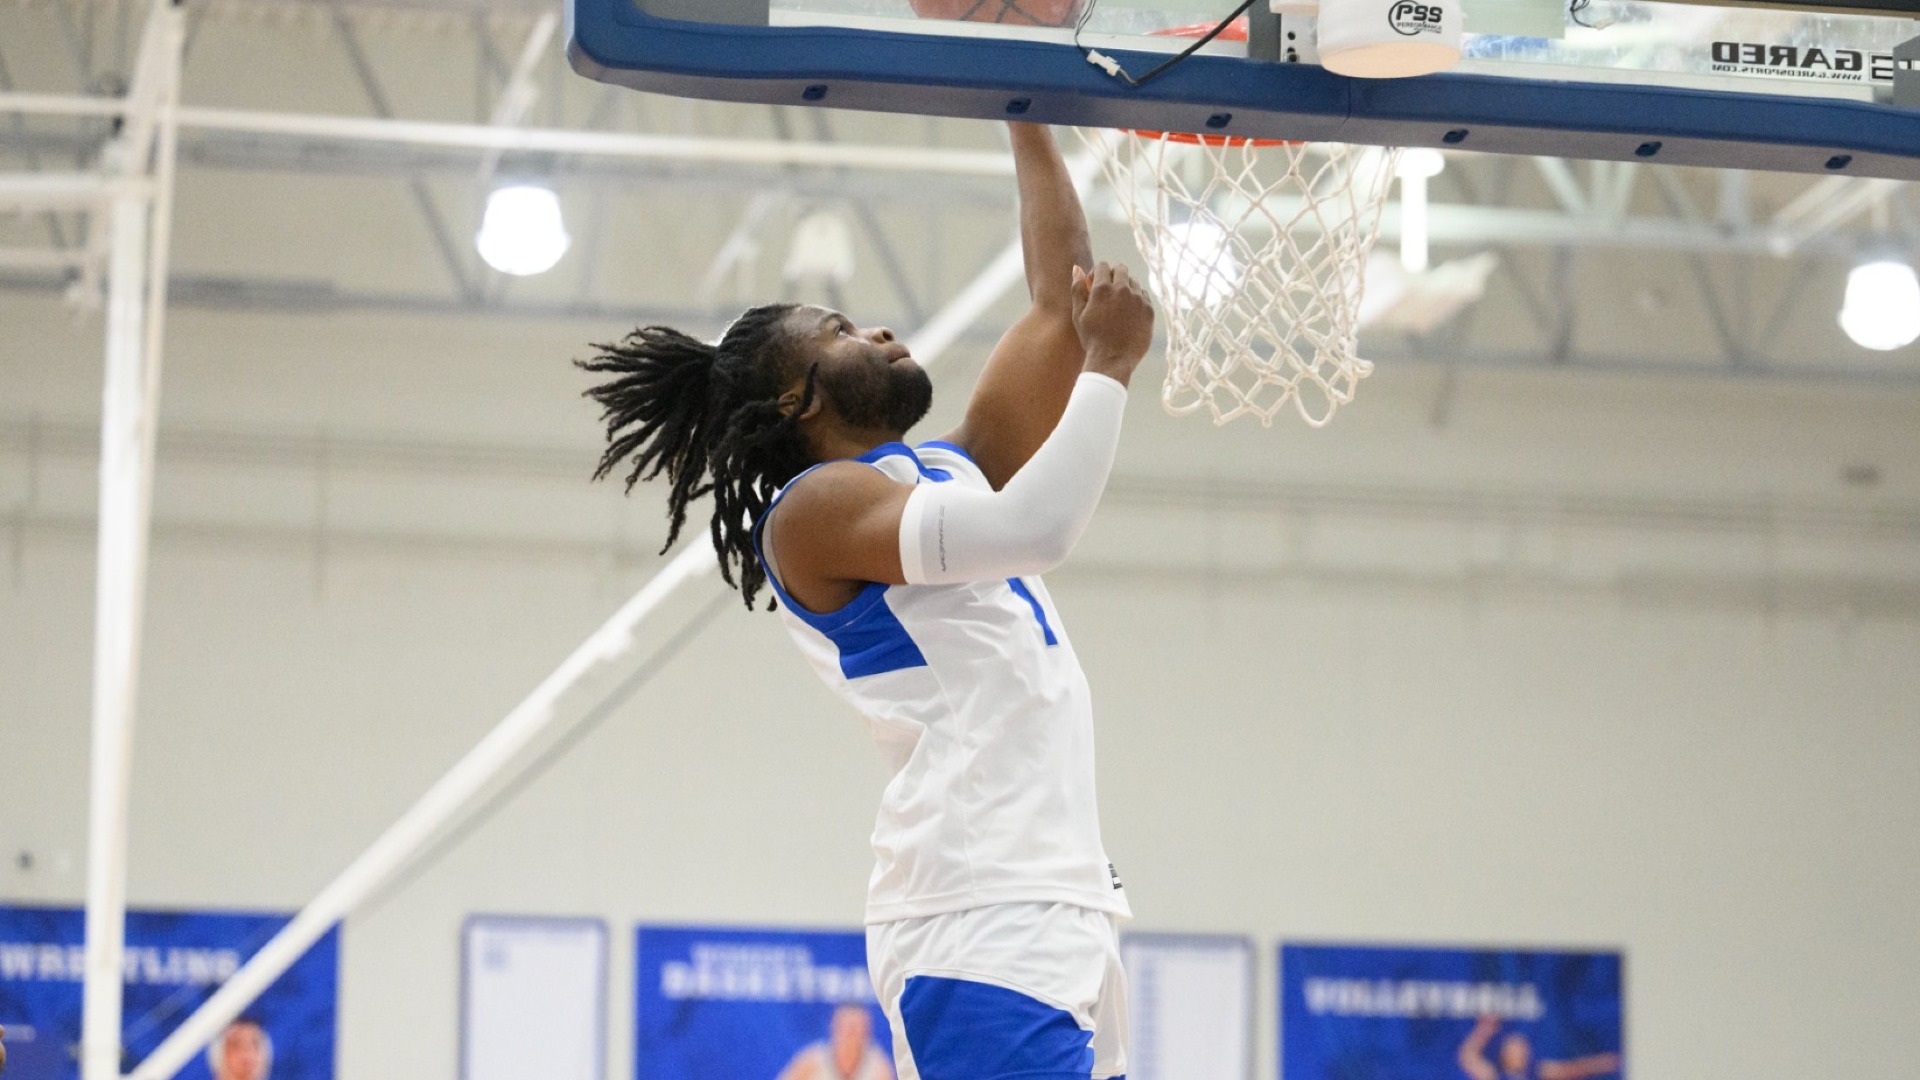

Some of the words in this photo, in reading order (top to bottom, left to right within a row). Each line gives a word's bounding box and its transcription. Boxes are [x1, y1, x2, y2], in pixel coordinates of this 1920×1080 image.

[1395, 4, 1443, 23] PSS
[0, 943, 239, 984] WRETLING
[1303, 978, 1545, 1020] VOLLEYBALL
